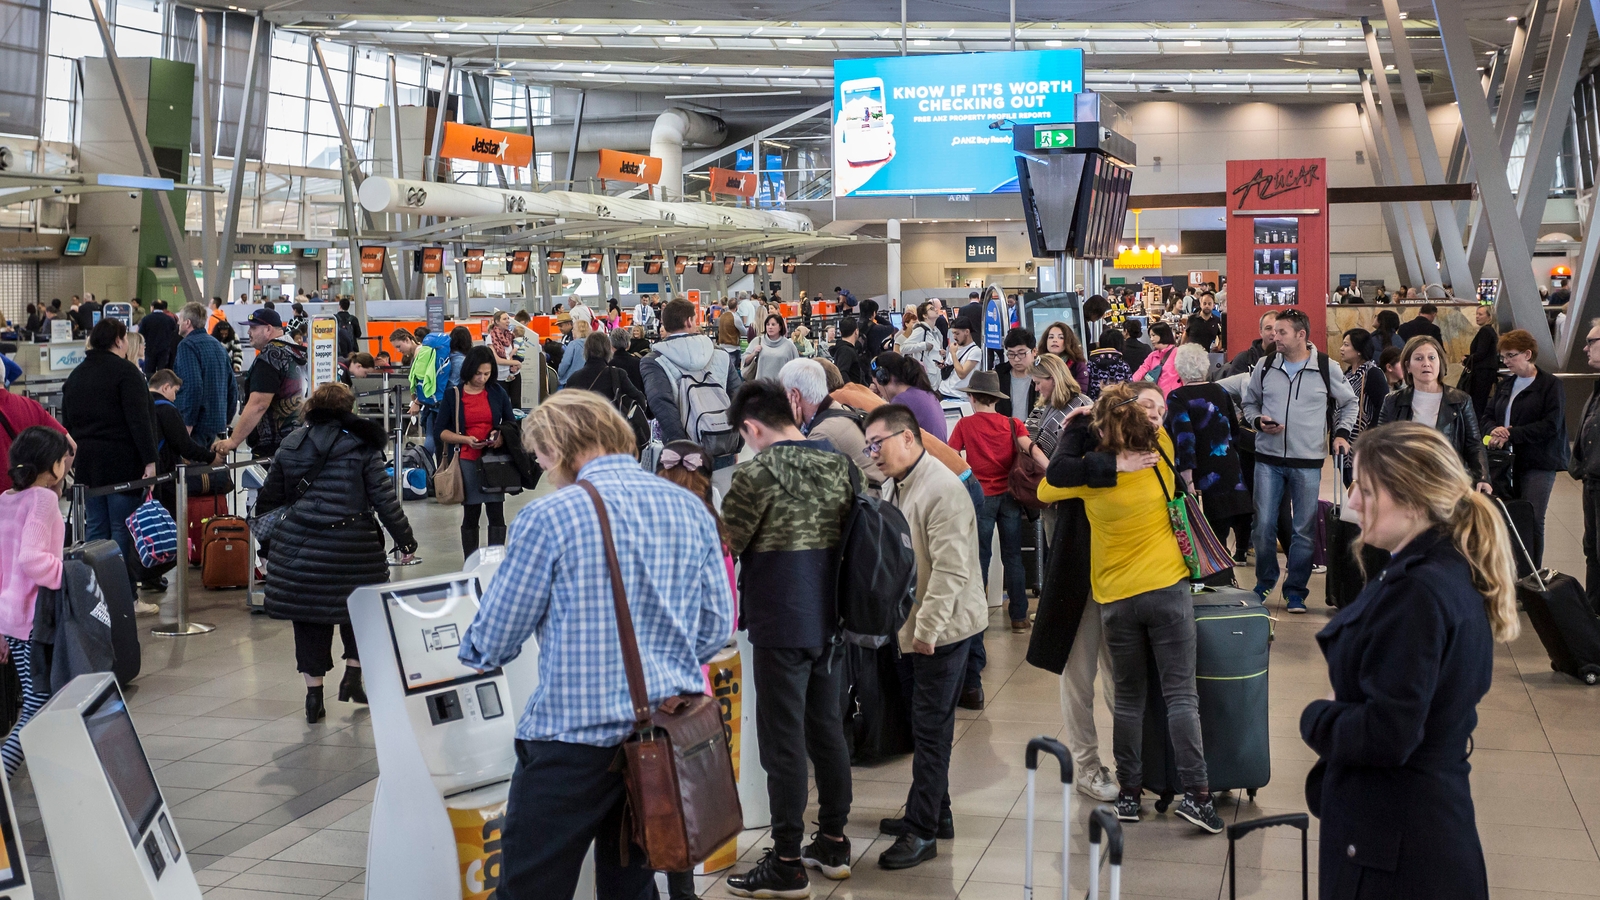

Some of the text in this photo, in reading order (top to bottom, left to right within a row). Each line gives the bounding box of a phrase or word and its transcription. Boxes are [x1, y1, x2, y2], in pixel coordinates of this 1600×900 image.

[893, 80, 1073, 99] KNOW IF IT'S WORTH
[918, 95, 1046, 112] CHECKING OUT
[949, 113, 986, 121] PROPERTY
[987, 112, 1017, 120] PROFILE
[1018, 111, 1052, 119] REPORTS
[960, 136, 977, 144] ANZ
[472, 137, 500, 155] Jetstar
[619, 160, 639, 175] Jetstar
[948, 194, 970, 202] APN
[234, 243, 274, 254] CURITY SCRE
[978, 246, 995, 255] Lift
[314, 324, 333, 334] tigerair
